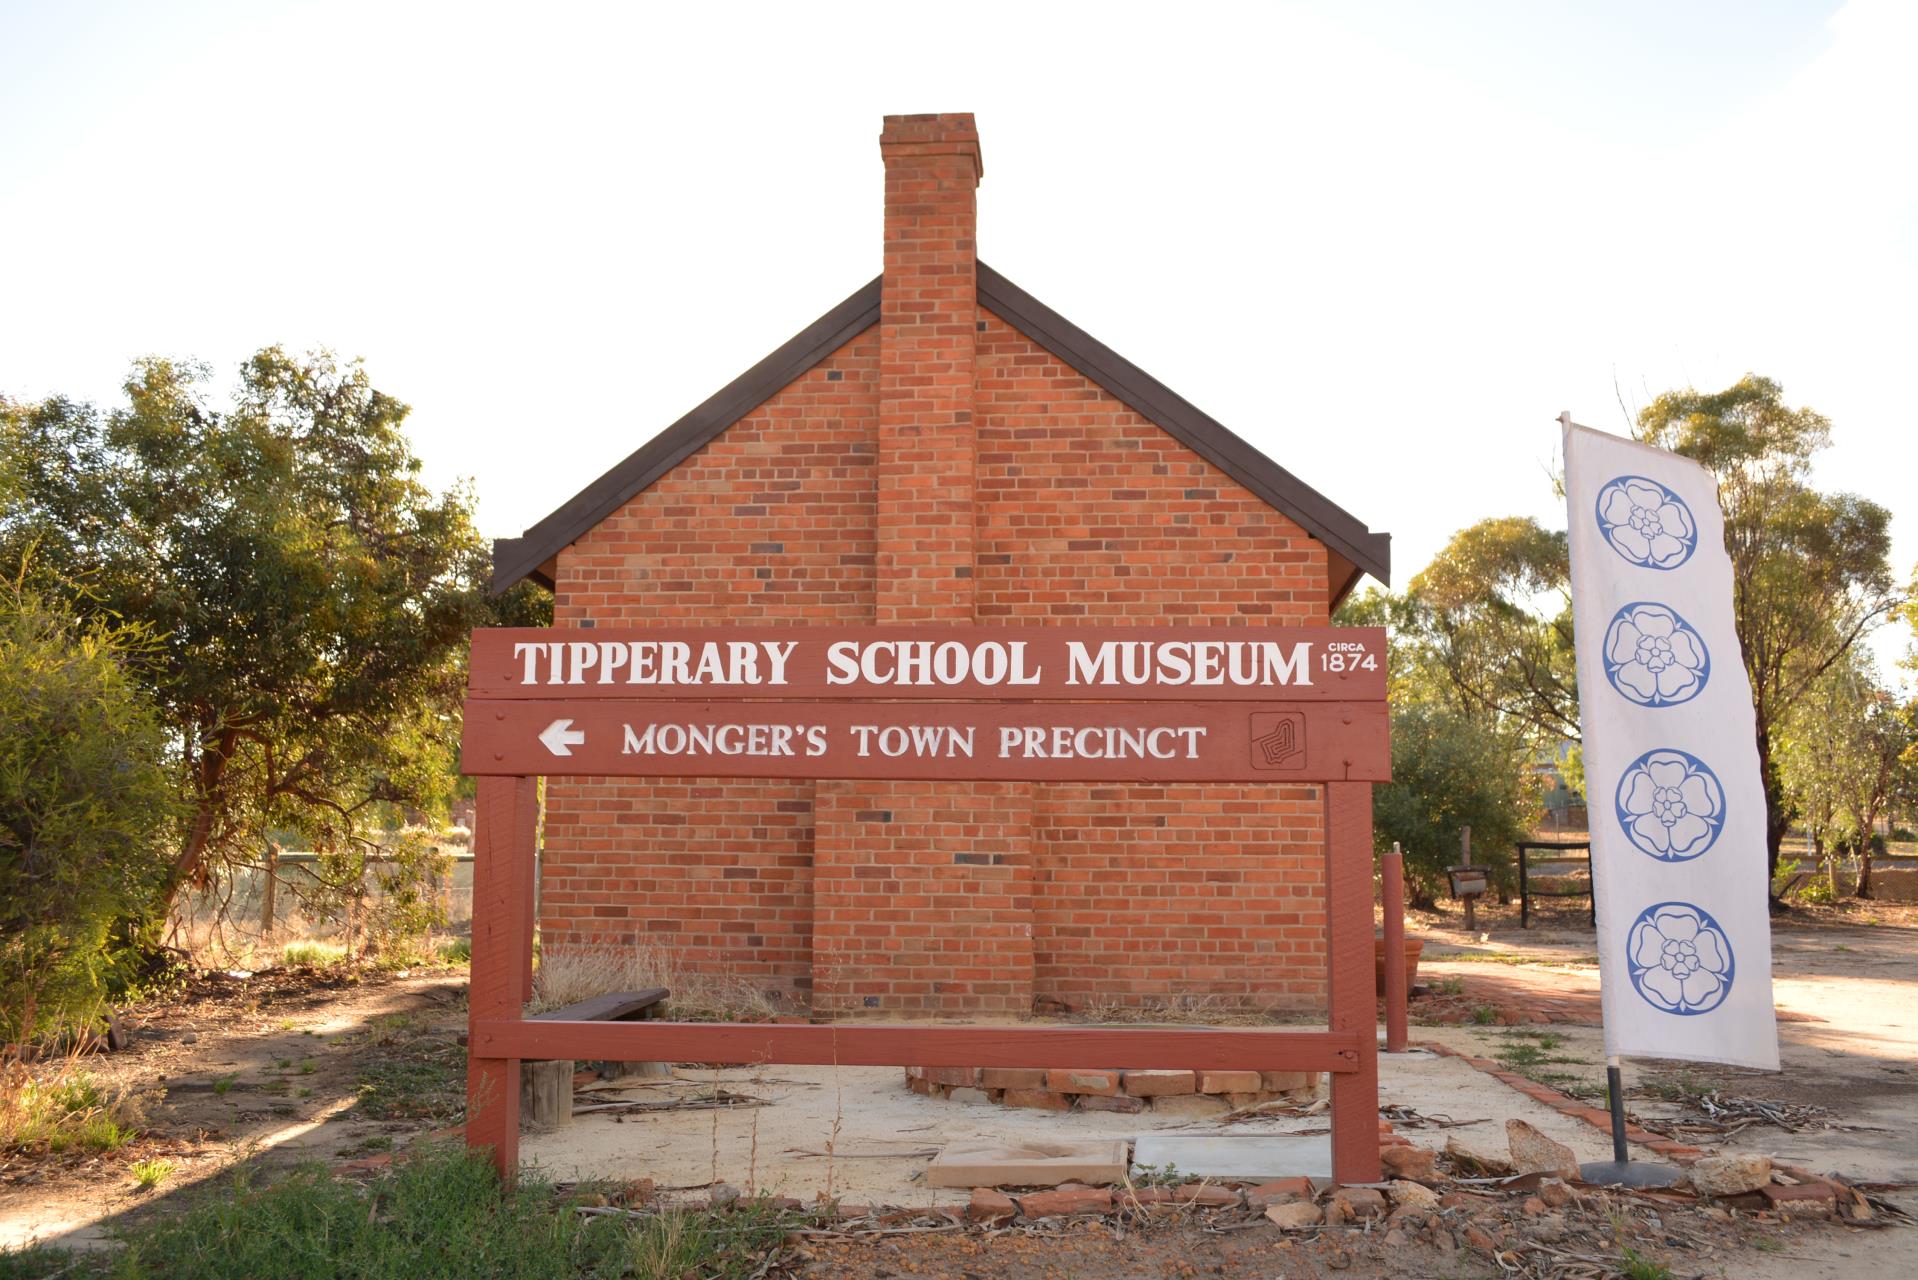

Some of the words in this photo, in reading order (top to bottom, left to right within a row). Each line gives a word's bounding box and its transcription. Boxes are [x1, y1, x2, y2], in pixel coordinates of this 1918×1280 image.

[1327, 642, 1366, 652] CIRCA
[513, 641, 800, 685] TIPPERARY
[826, 640, 1042, 686] SCHOOL
[1064, 641, 1314, 686] MUSEUM
[1320, 653, 1379, 673] 1874
[621, 723, 827, 757] MONGER'S
[850, 725, 976, 758] TOWN
[998, 726, 1207, 759] PRECINCT
